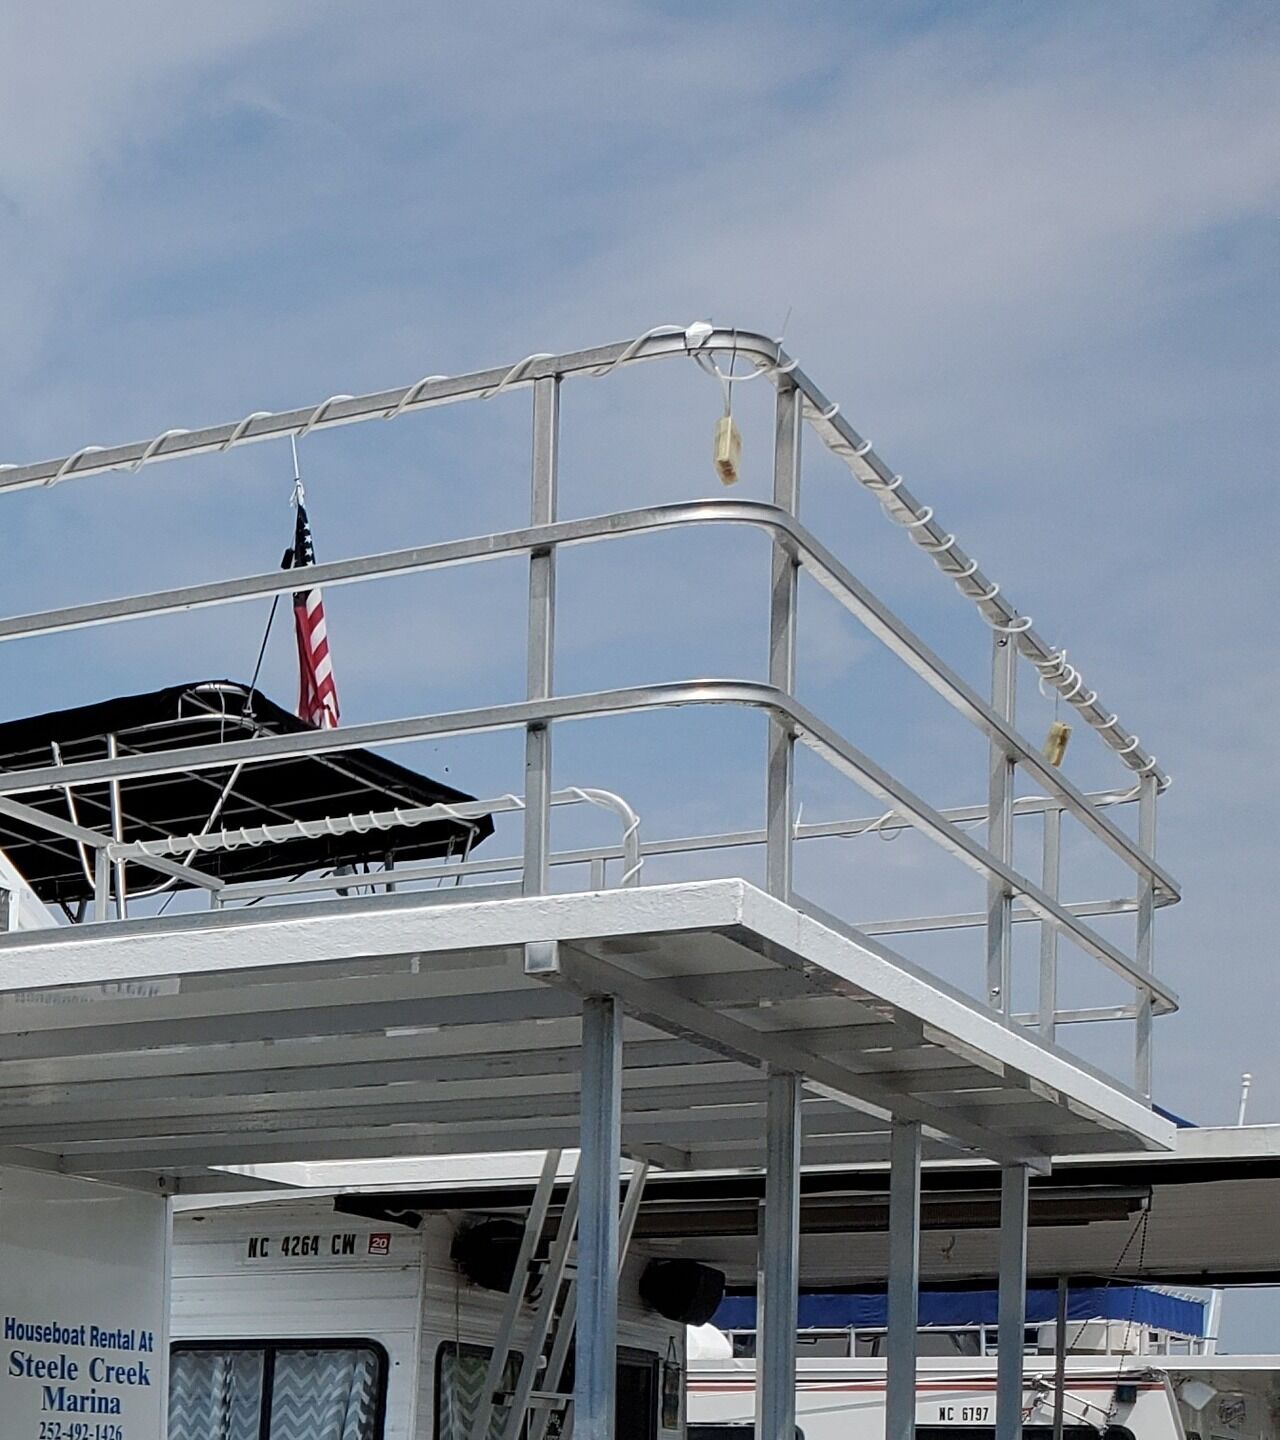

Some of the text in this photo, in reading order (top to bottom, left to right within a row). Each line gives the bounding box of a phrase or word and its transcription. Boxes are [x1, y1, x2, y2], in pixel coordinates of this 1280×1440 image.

[248, 1234, 388, 1258] NC 4264 CW 20
[4, 1317, 153, 1352] Houseboat Rental At
[8, 1350, 151, 1386] Steele Creek
[41, 1386, 121, 1415] Marina
[939, 1407, 954, 1421] NC
